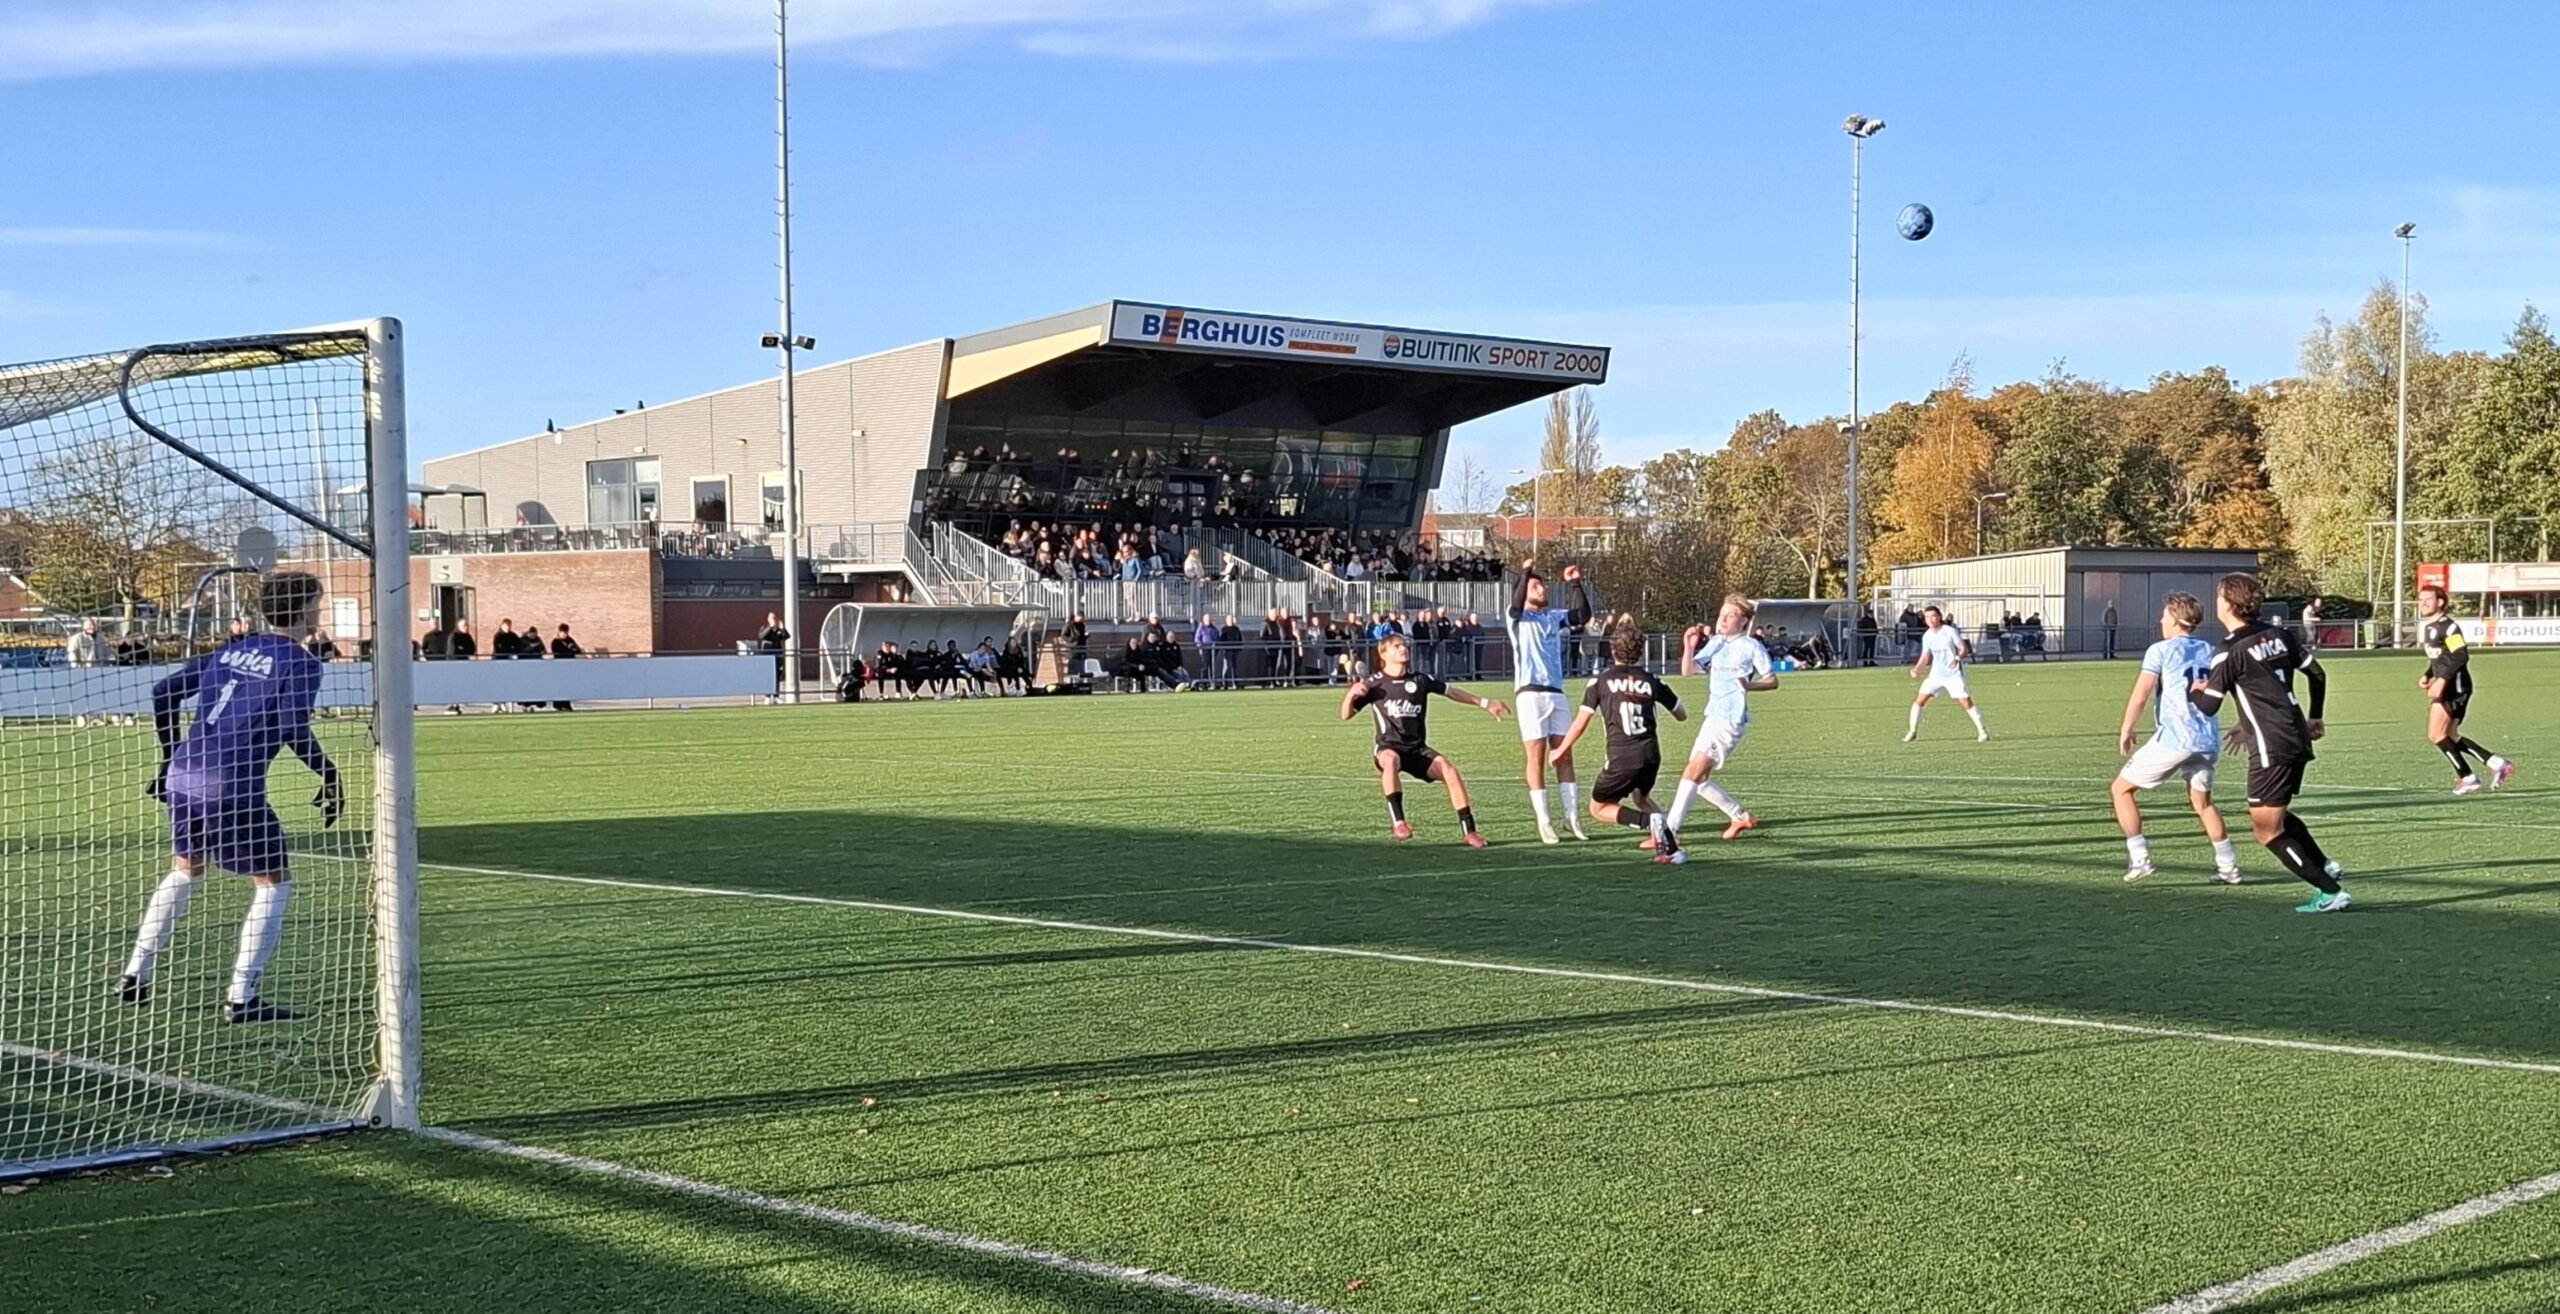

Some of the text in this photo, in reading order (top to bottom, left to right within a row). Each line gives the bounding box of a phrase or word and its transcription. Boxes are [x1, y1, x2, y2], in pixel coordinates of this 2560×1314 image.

[1142, 313, 1285, 347] BERGHUIS
[1488, 346, 1550, 369] SPORT
[1553, 352, 1602, 373] 2000
[206, 679, 238, 725] 1
